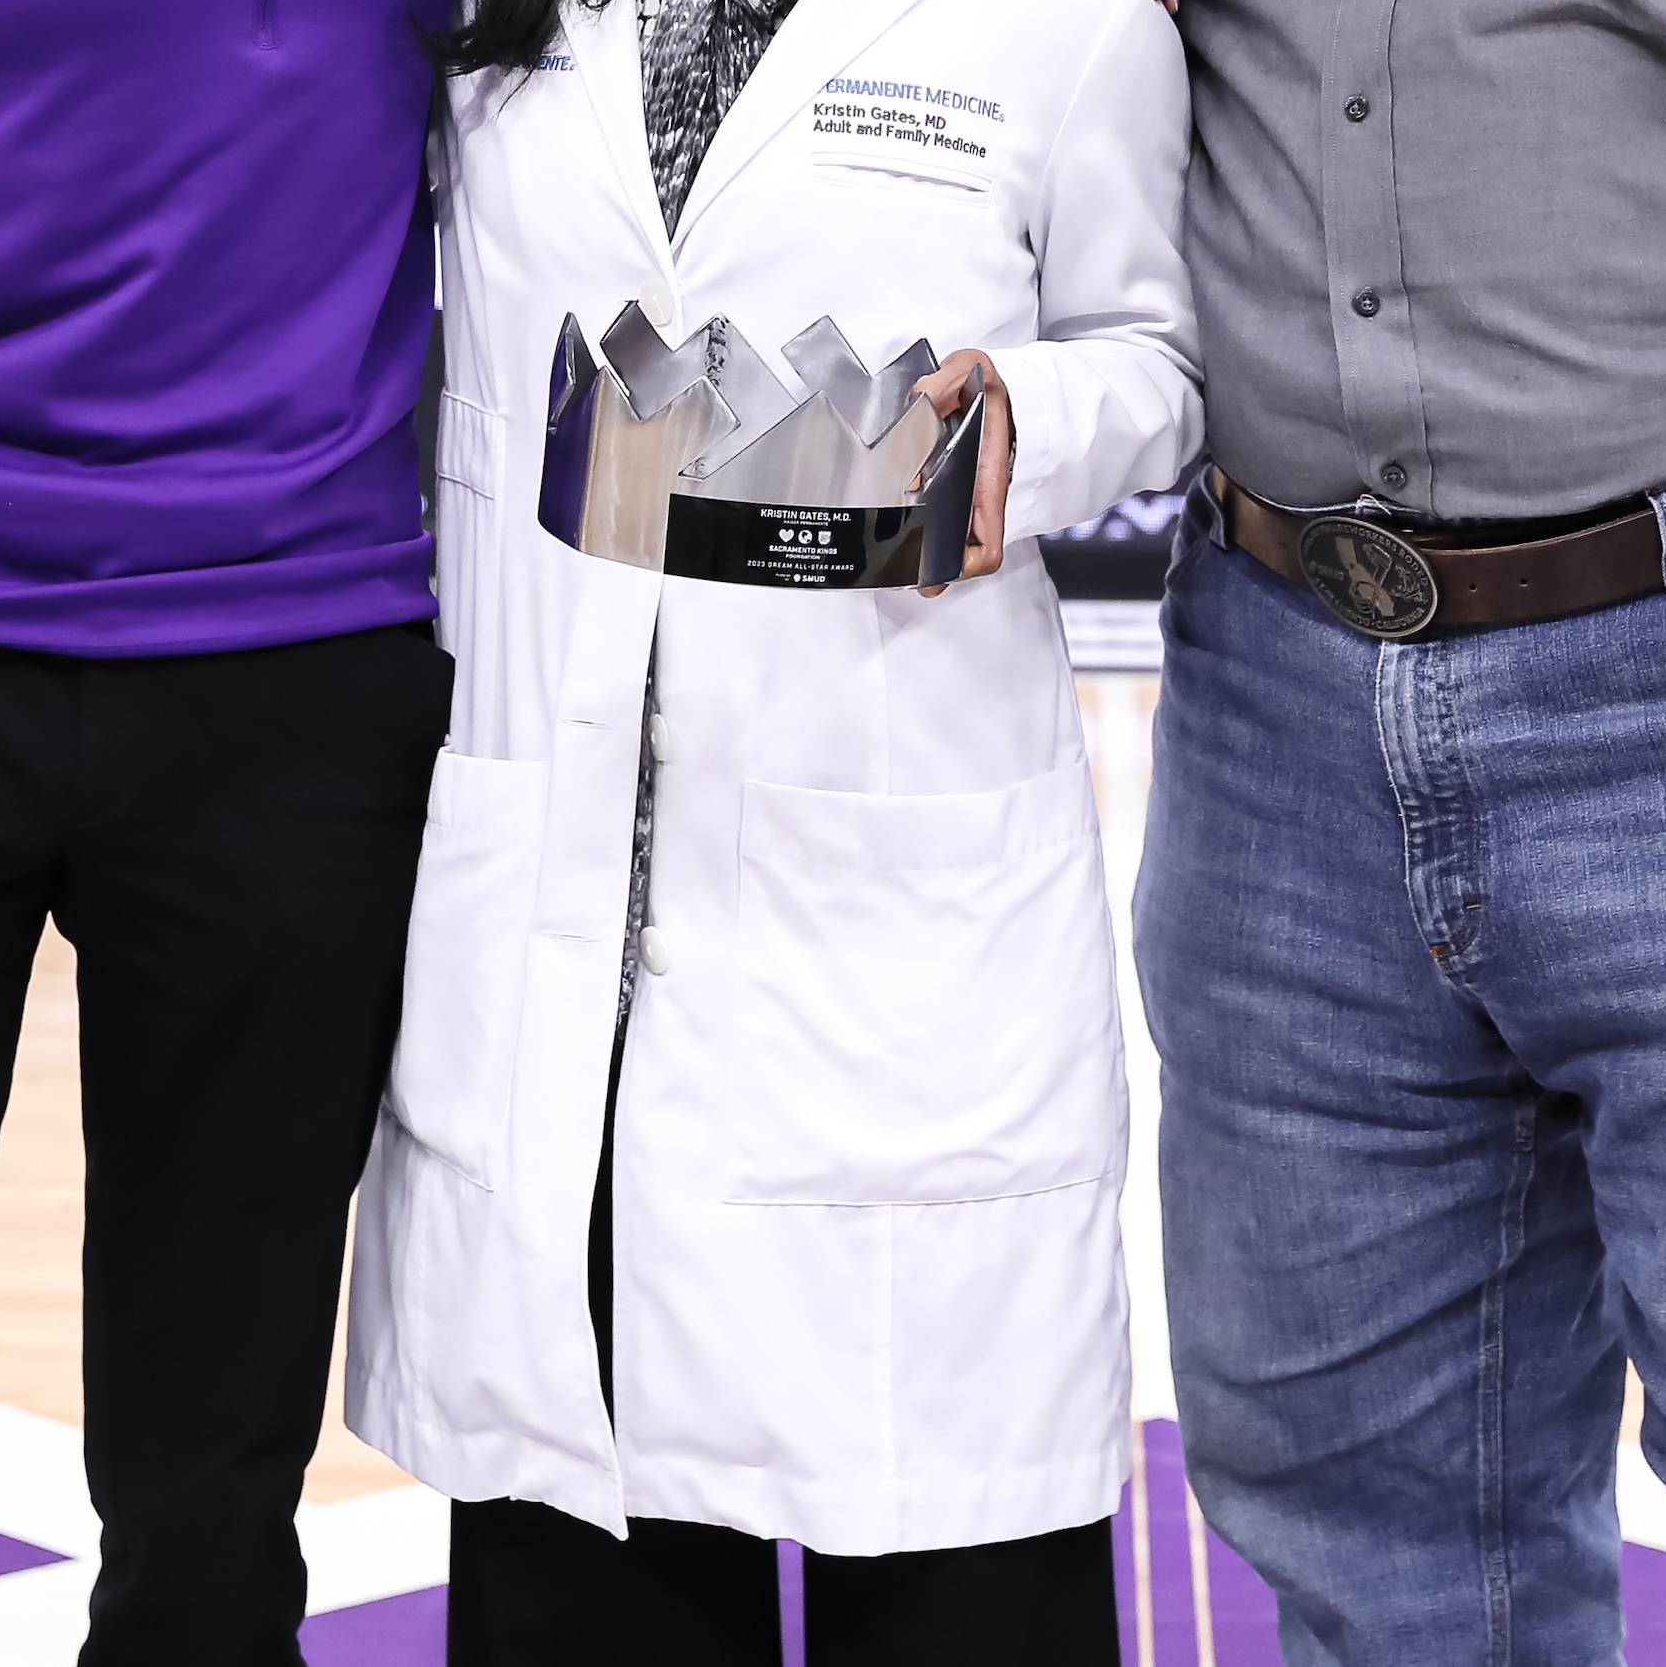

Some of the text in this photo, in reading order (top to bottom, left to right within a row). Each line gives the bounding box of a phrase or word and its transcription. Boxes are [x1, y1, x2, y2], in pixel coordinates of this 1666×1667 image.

[814, 103, 946, 130] Kristin Gates, MD
[813, 119, 986, 158] Adult and Family Medicine
[760, 508, 851, 522] KRISTIN GATES, M.D.
[769, 545, 837, 555] SACRAMENTO KINGS
[768, 561, 792, 569] DREAM
[802, 575, 826, 583] SMUD
